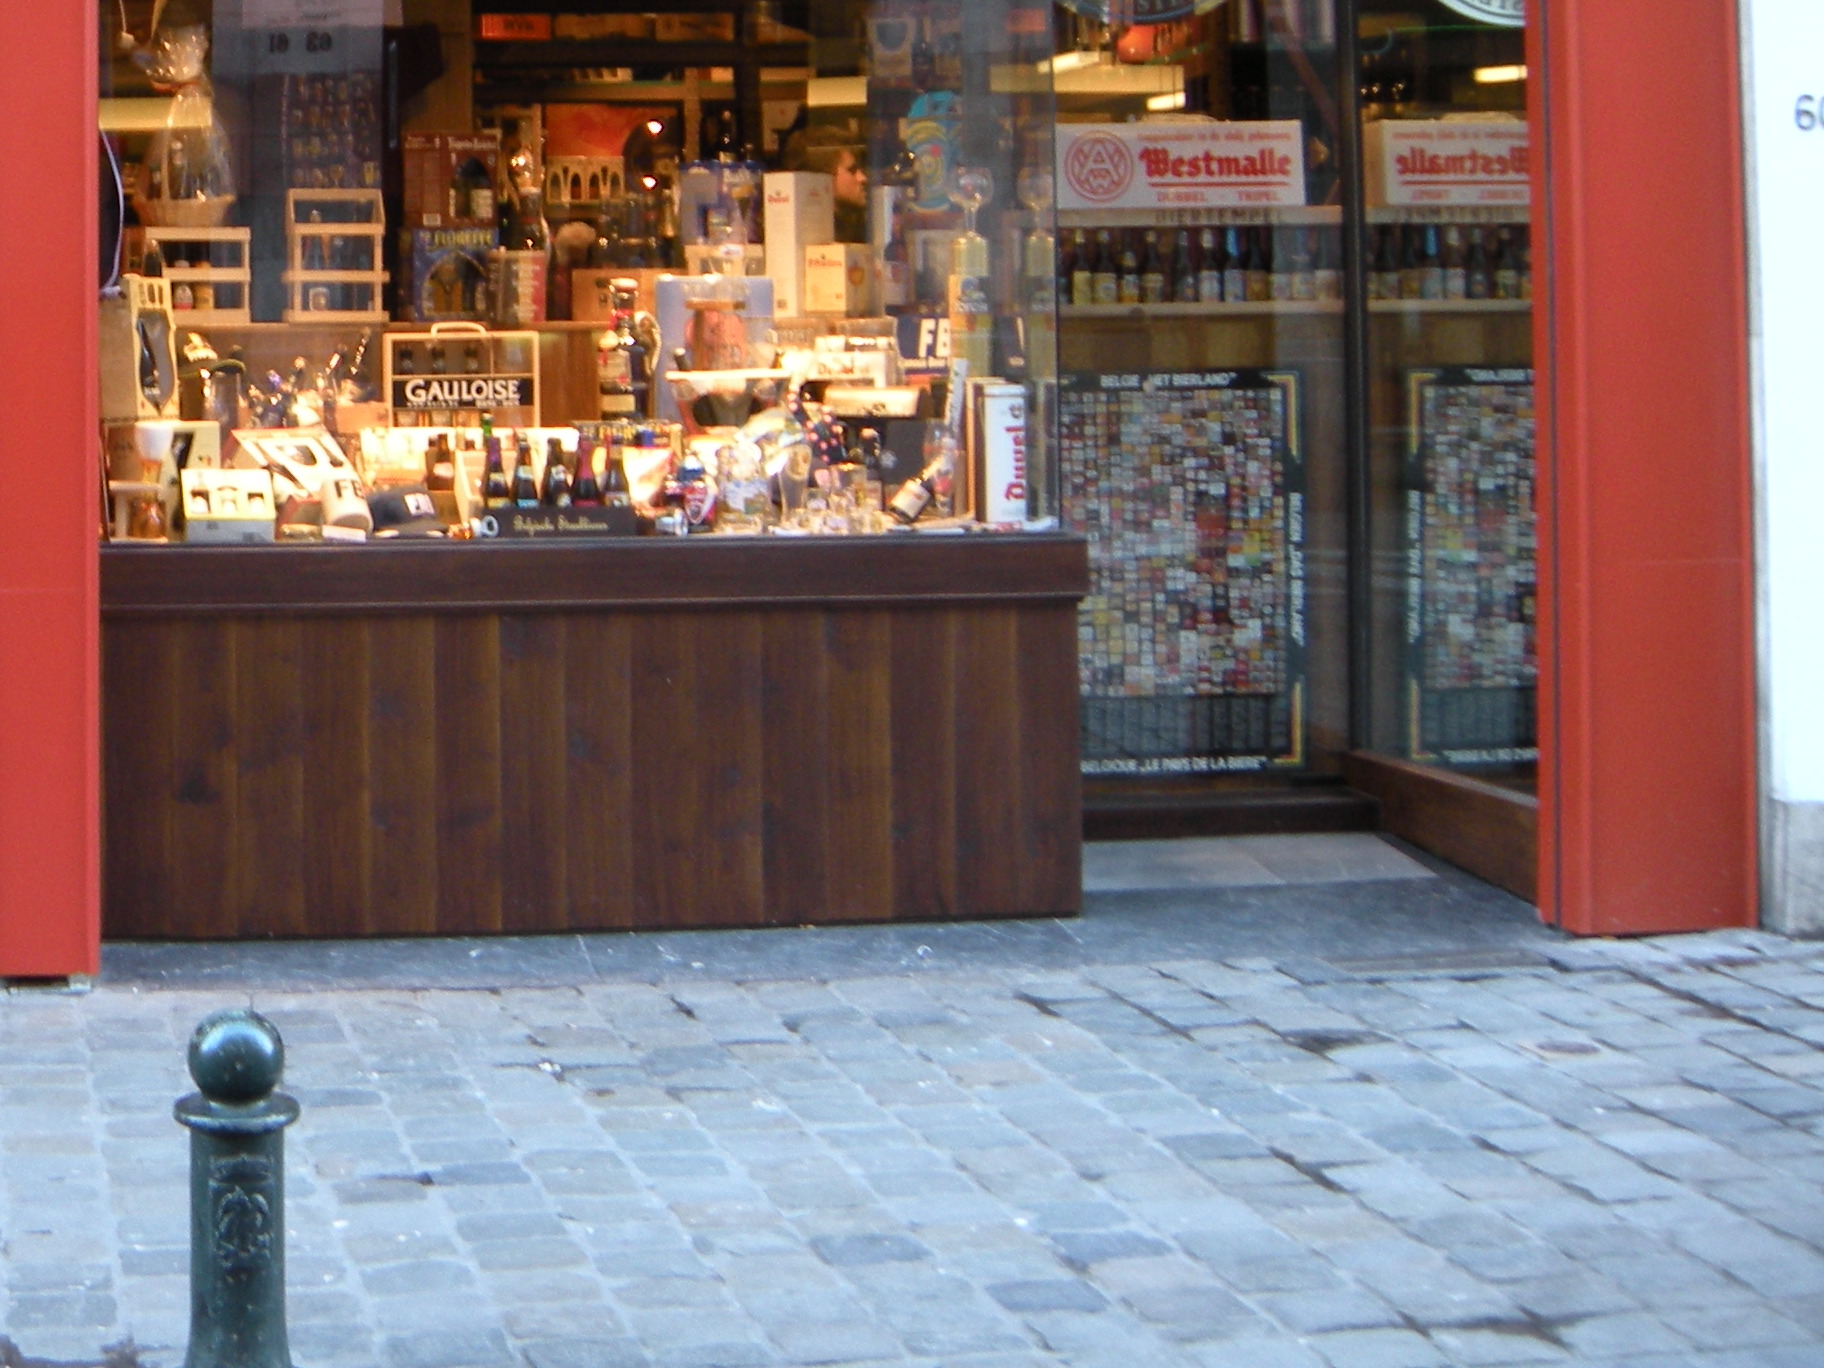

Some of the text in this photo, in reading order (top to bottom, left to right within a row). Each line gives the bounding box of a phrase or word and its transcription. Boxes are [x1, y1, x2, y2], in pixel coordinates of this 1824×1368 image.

[1794, 94, 1824, 132] 6
[1139, 146, 1292, 178] Westmalle
[404, 379, 521, 402] GAULOISE
